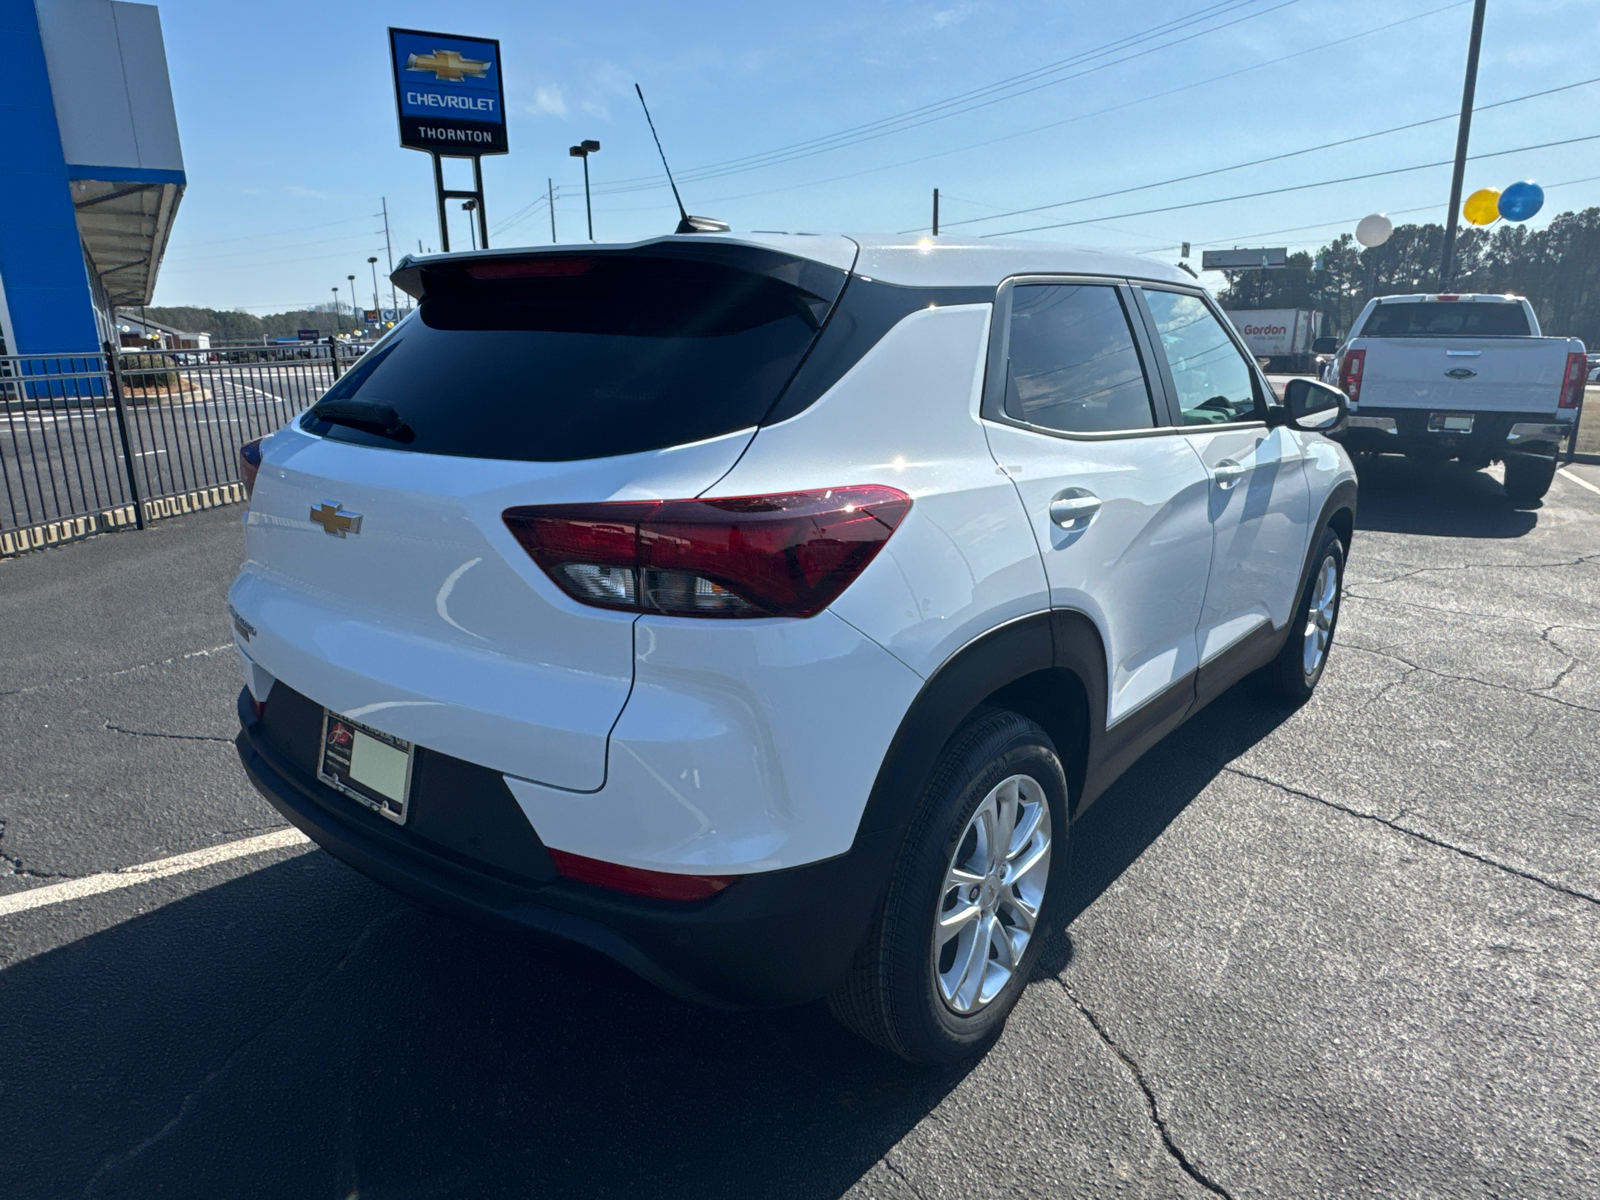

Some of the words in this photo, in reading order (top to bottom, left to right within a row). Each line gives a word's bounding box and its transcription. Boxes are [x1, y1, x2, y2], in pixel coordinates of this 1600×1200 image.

[407, 92, 495, 111] CHEVROLET
[418, 126, 492, 142] THORNTON
[1244, 324, 1287, 335] Gordon
